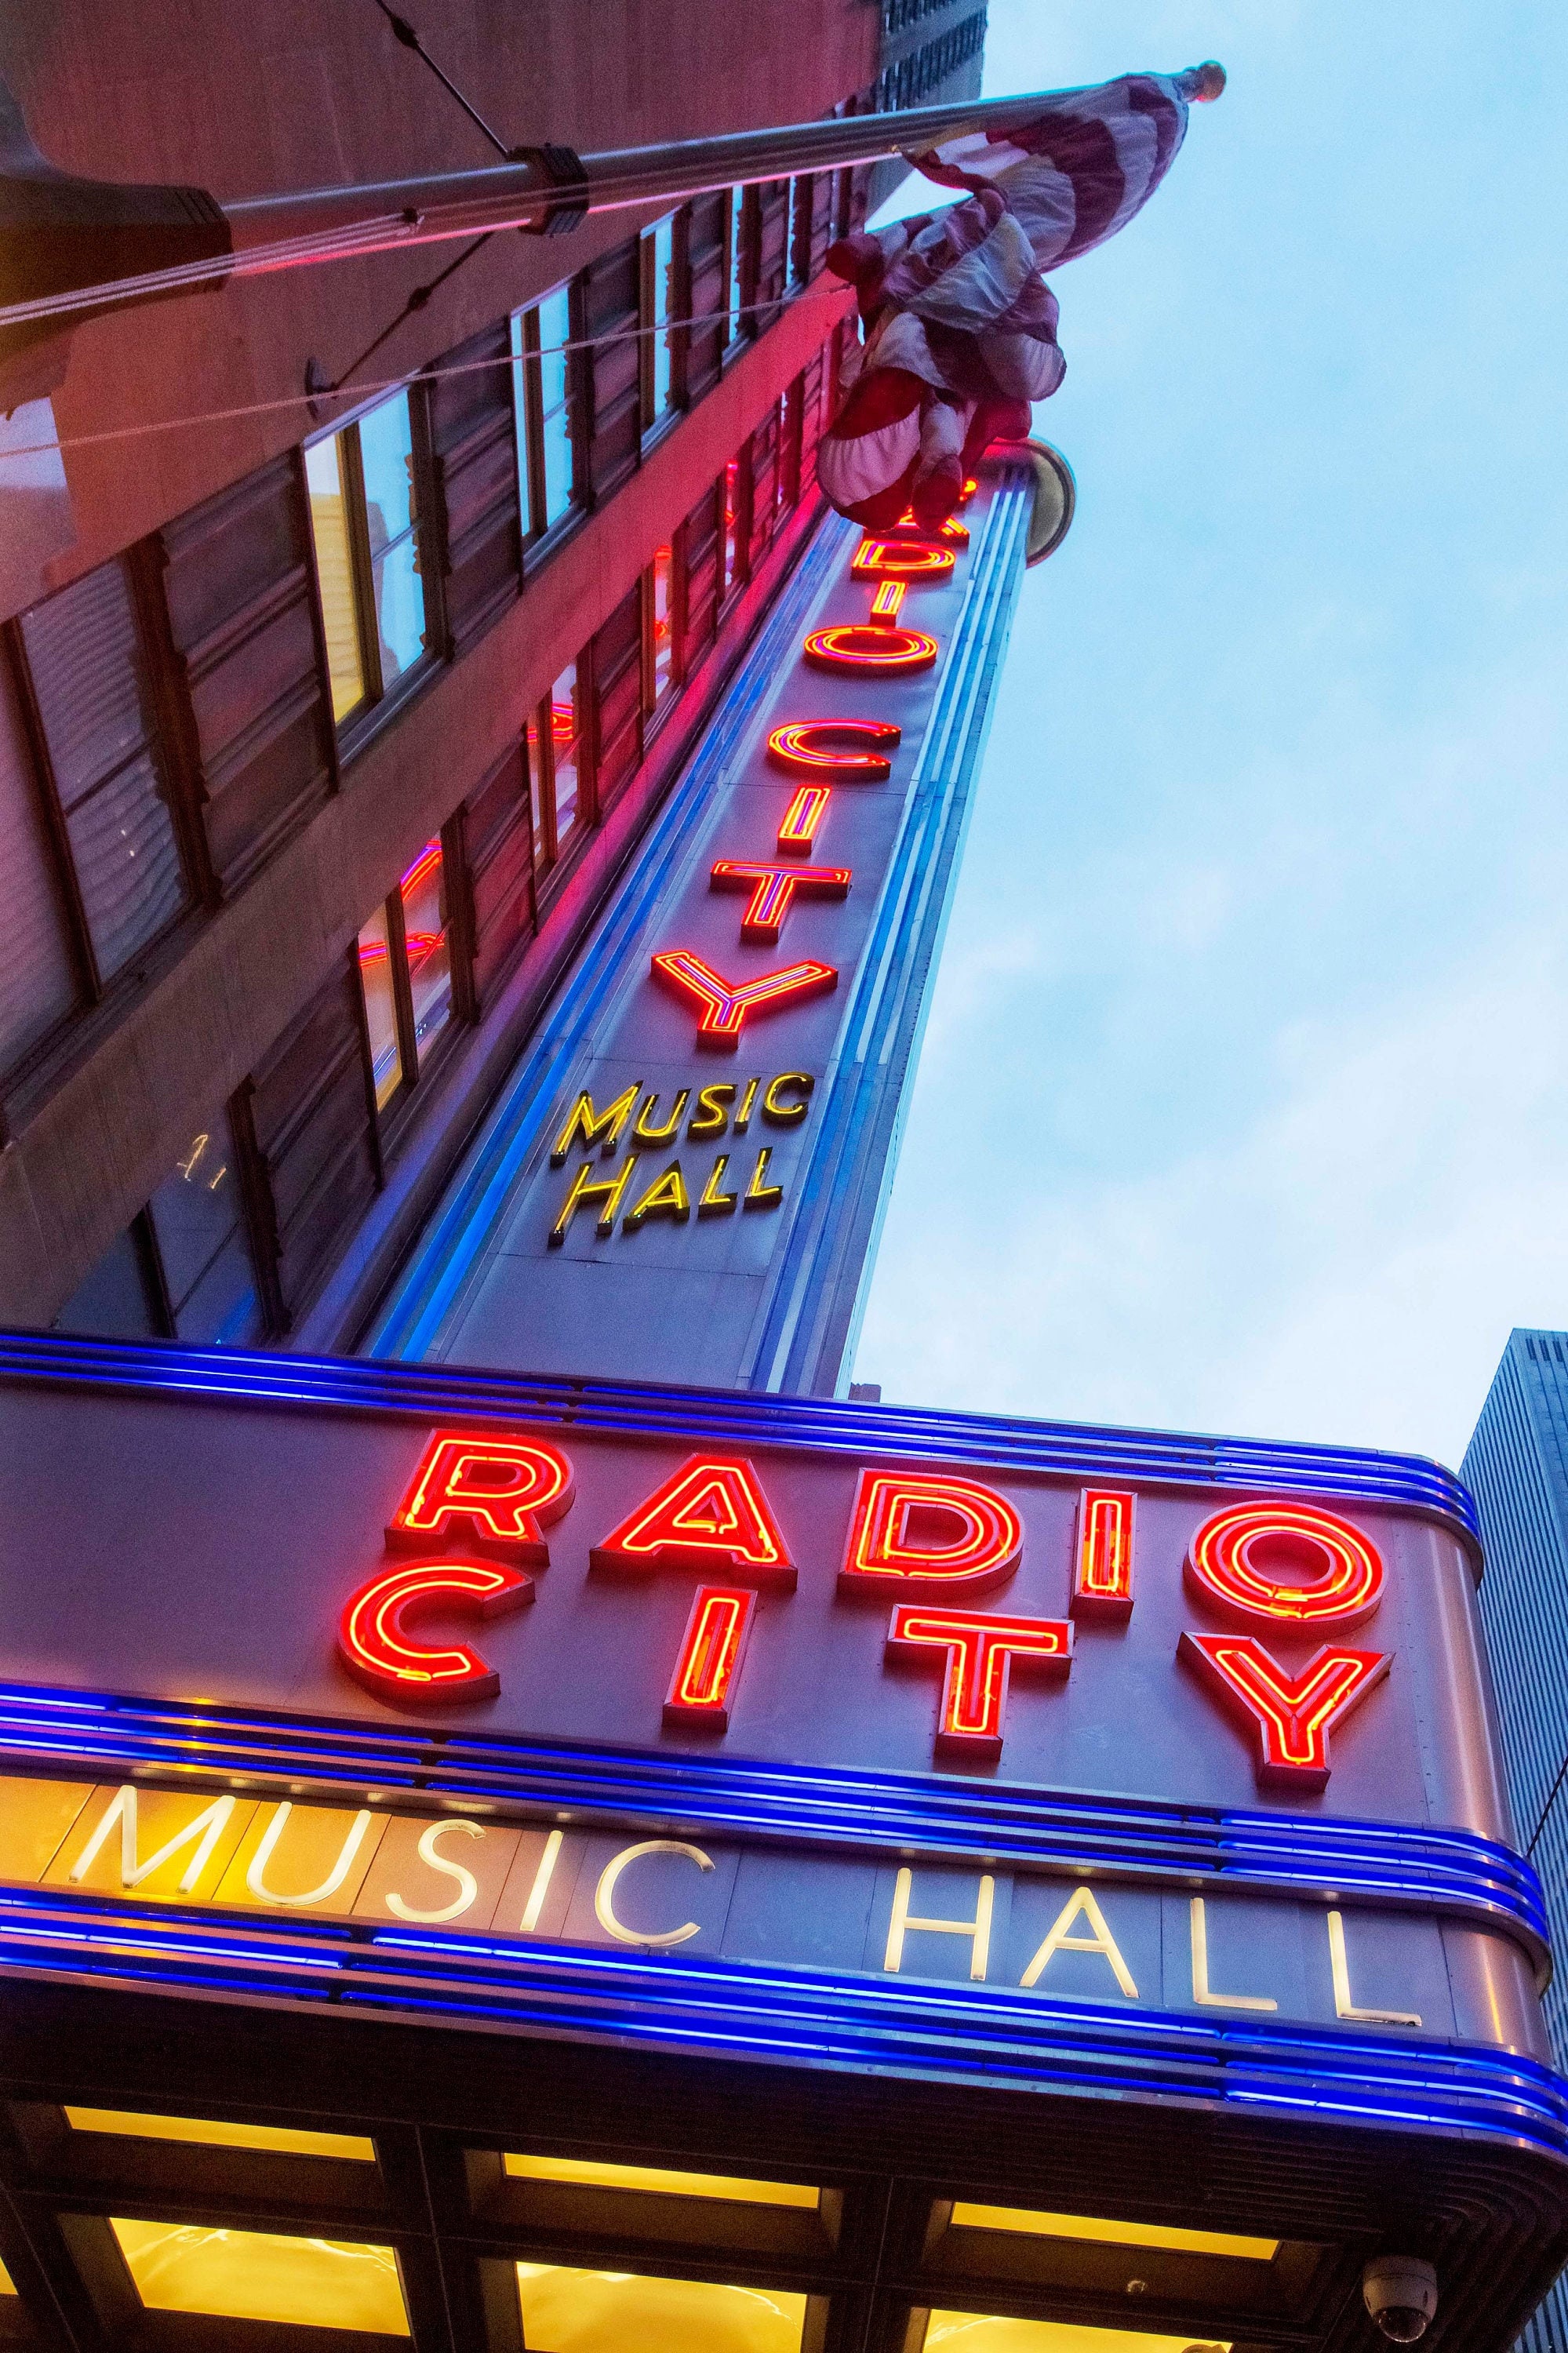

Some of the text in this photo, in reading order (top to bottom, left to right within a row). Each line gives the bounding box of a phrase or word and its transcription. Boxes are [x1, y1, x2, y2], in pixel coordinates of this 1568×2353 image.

[803, 477, 979, 667] DIO
[651, 719, 901, 1051] CITY
[548, 1147, 783, 1246] HALL
[551, 1071, 814, 1166] MUSIC
[384, 1427, 1386, 1639] RADIO
[337, 1555, 1395, 1792] CITY
[68, 1784, 1423, 2027] MUSIC HALL
